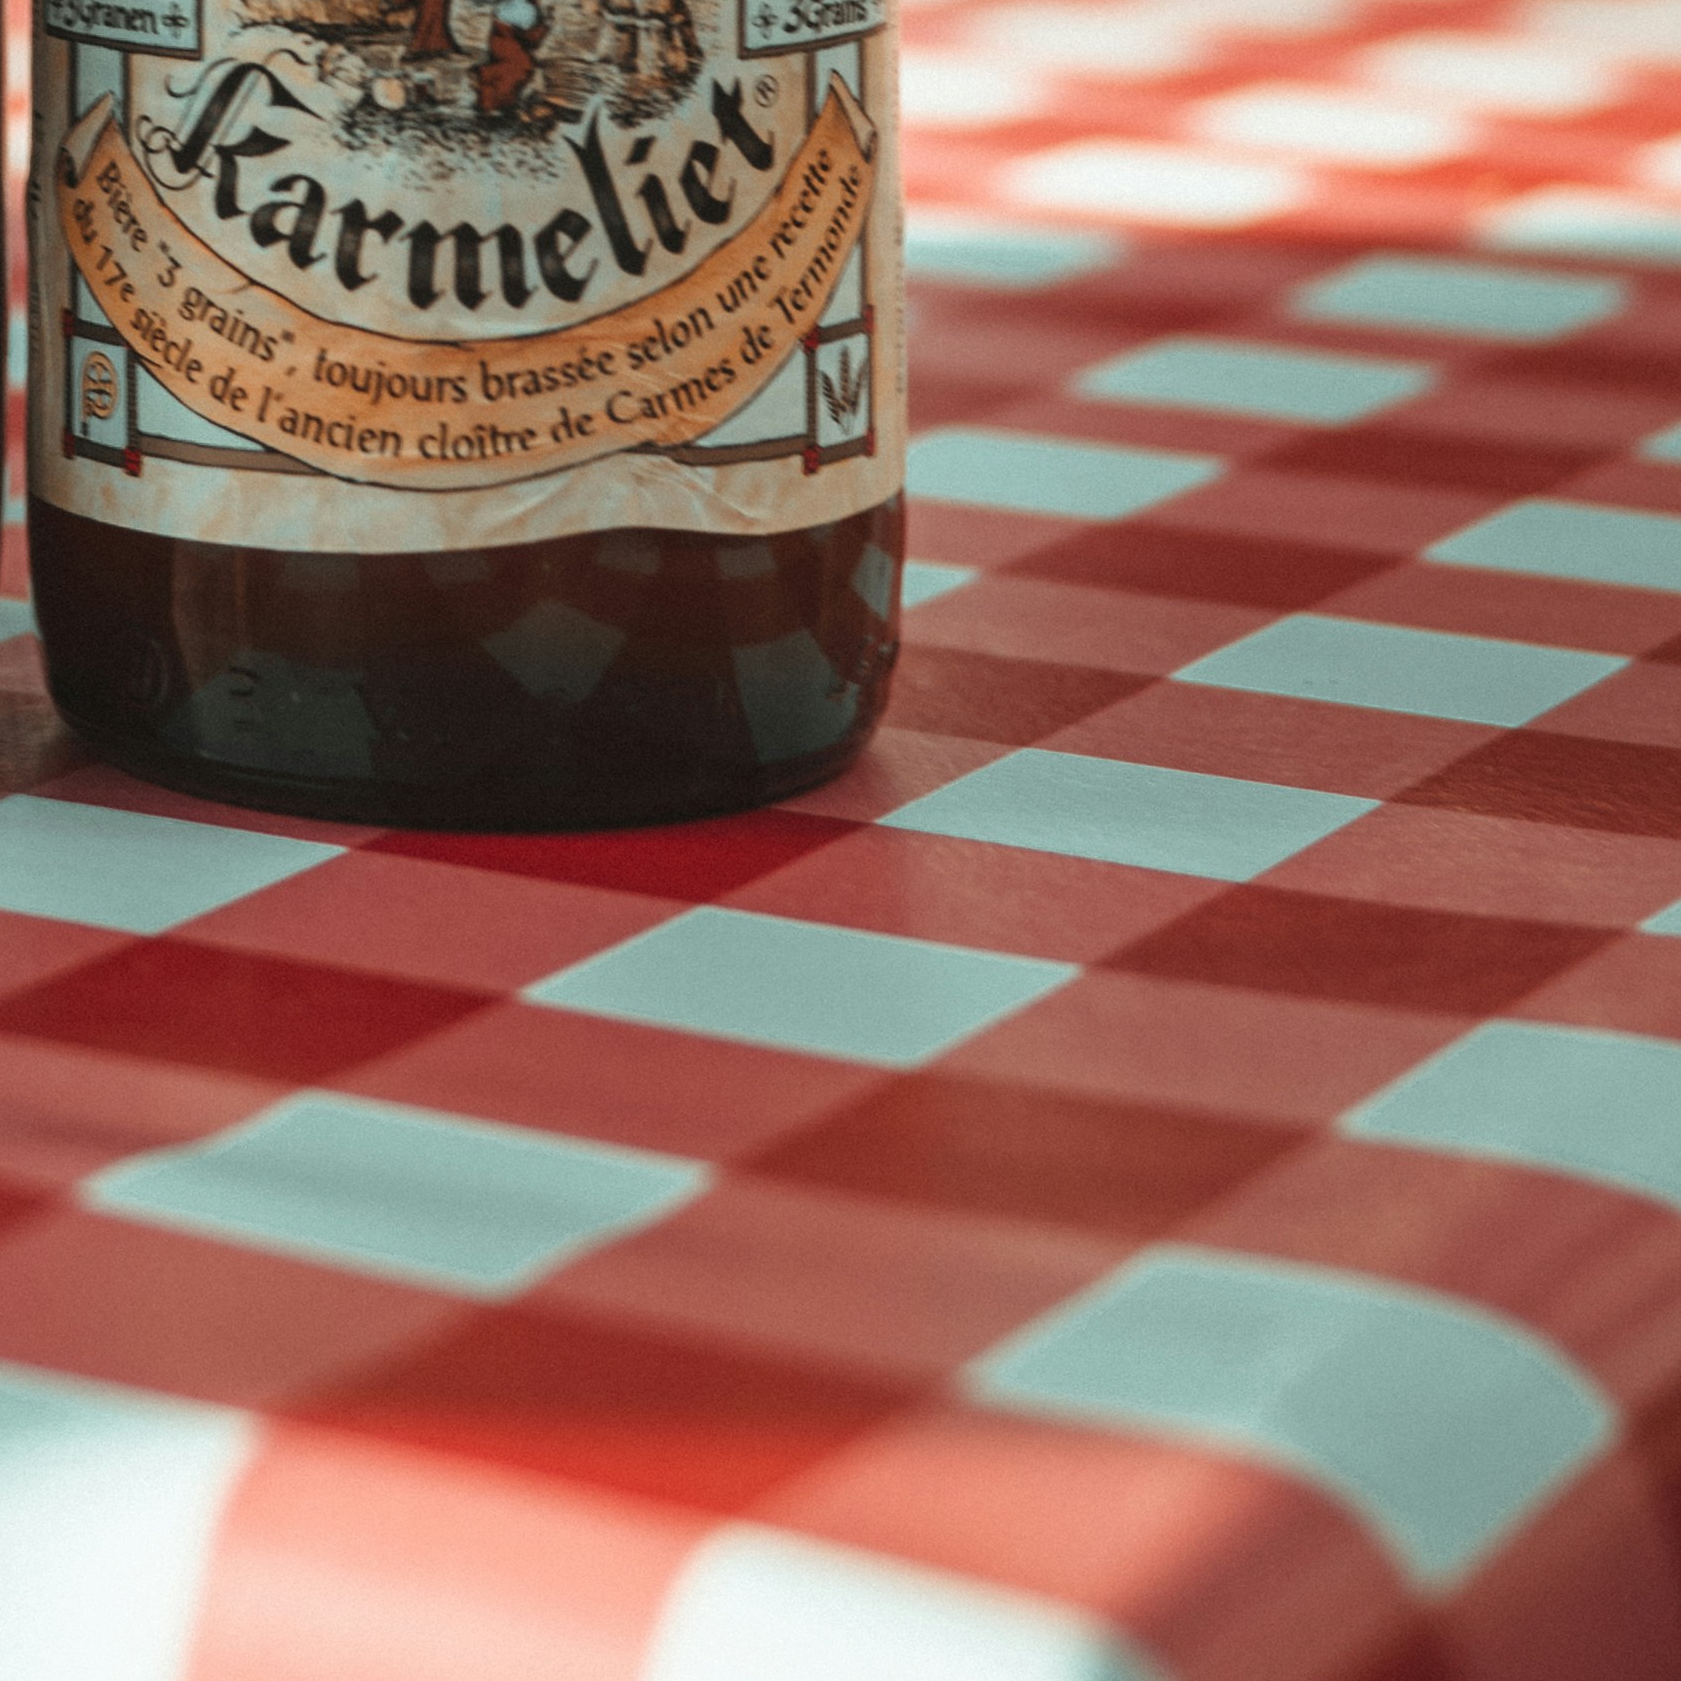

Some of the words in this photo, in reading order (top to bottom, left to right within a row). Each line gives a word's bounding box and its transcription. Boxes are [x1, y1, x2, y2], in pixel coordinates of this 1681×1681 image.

[137, 47, 775, 311] Karmeliet
[313, 347, 469, 406] toujours
[478, 345, 615, 403] brassée
[626, 306, 716, 371] selon
[715, 254, 772, 314] une
[769, 148, 832, 260] recette
[73, 197, 98, 244] du
[208, 367, 250, 412] de
[257, 387, 401, 458] l'ancien
[419, 421, 538, 461] cloître
[550, 406, 595, 444] de
[605, 357, 738, 425] Carmes
[739, 323, 773, 366] de
[768, 164, 862, 326] Termonde
